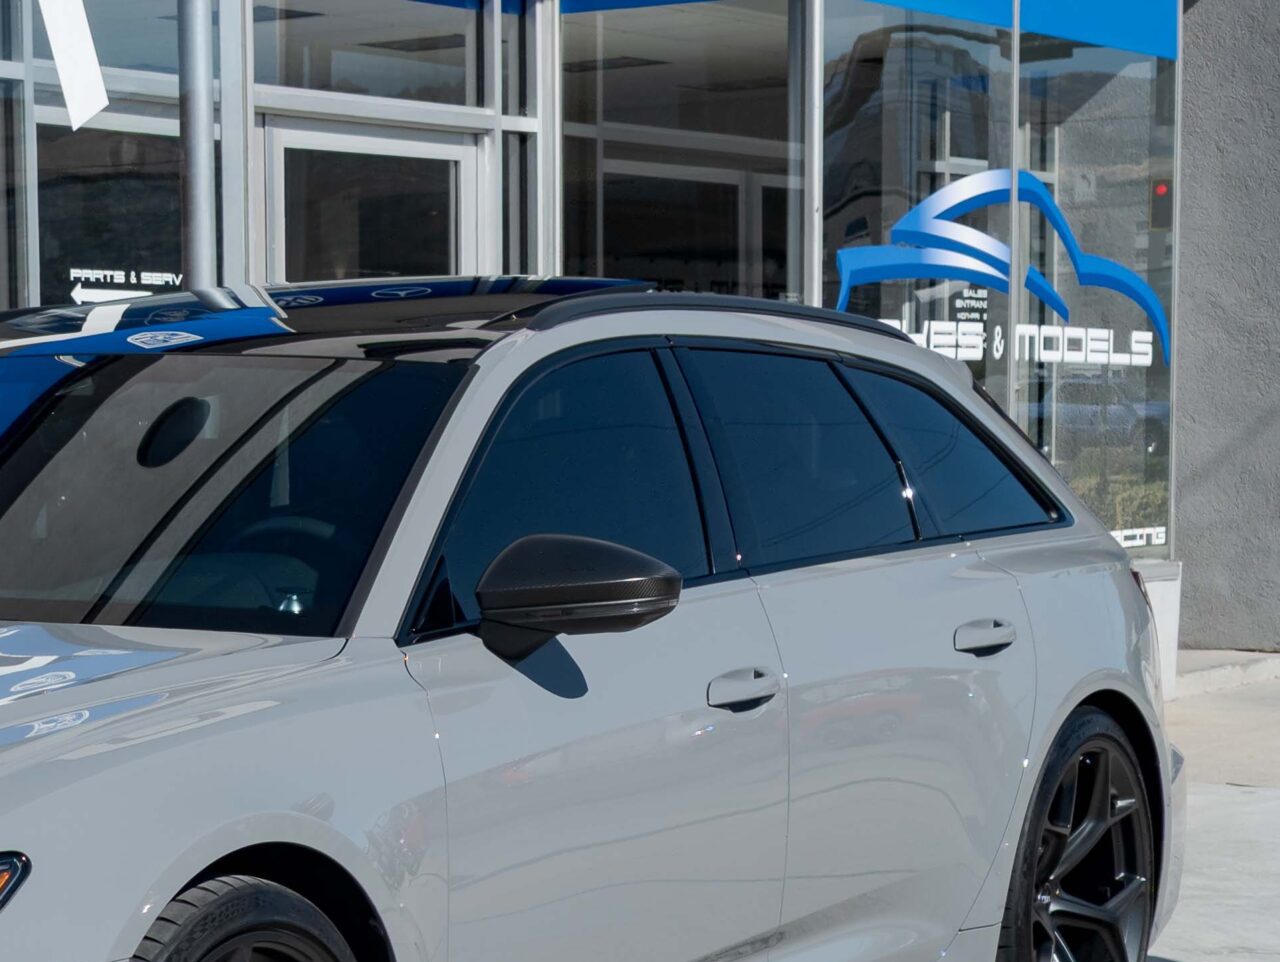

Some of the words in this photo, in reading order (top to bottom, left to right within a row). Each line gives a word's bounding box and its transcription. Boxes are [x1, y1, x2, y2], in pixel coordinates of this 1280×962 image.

[69, 268, 125, 284] PARTS
[130, 270, 138, 283] &
[140, 271, 183, 286] SERV
[992, 324, 1005, 361] &
[1015, 323, 1154, 366] MODELS
